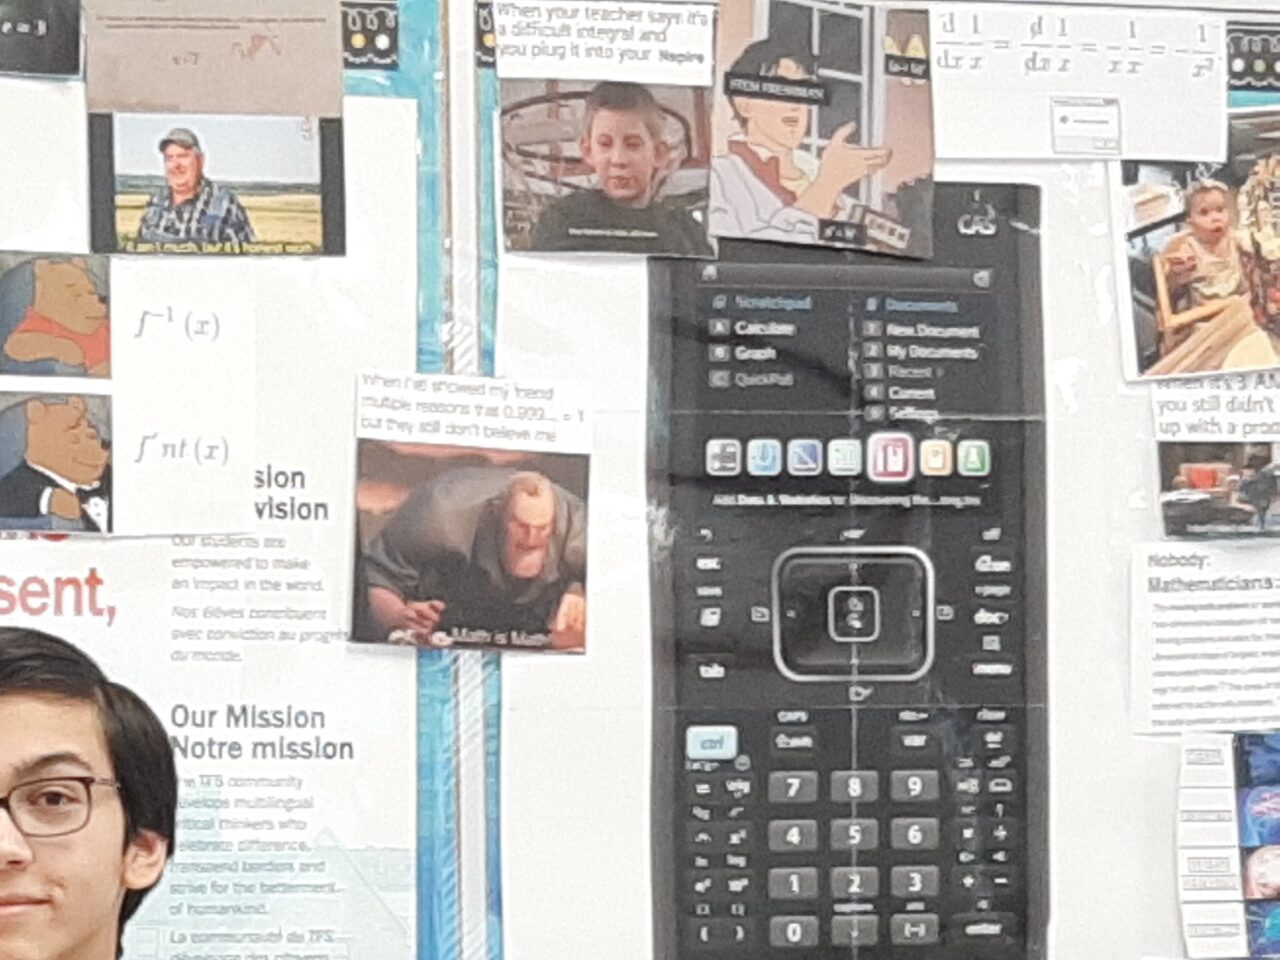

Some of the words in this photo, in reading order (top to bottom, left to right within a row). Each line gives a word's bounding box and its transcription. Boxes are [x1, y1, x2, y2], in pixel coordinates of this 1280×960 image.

[254, 464, 306, 489] sion
[171, 704, 218, 729] Our
[226, 704, 325, 729] Mission
[171, 735, 243, 760] Notre
[252, 735, 354, 760] mission
